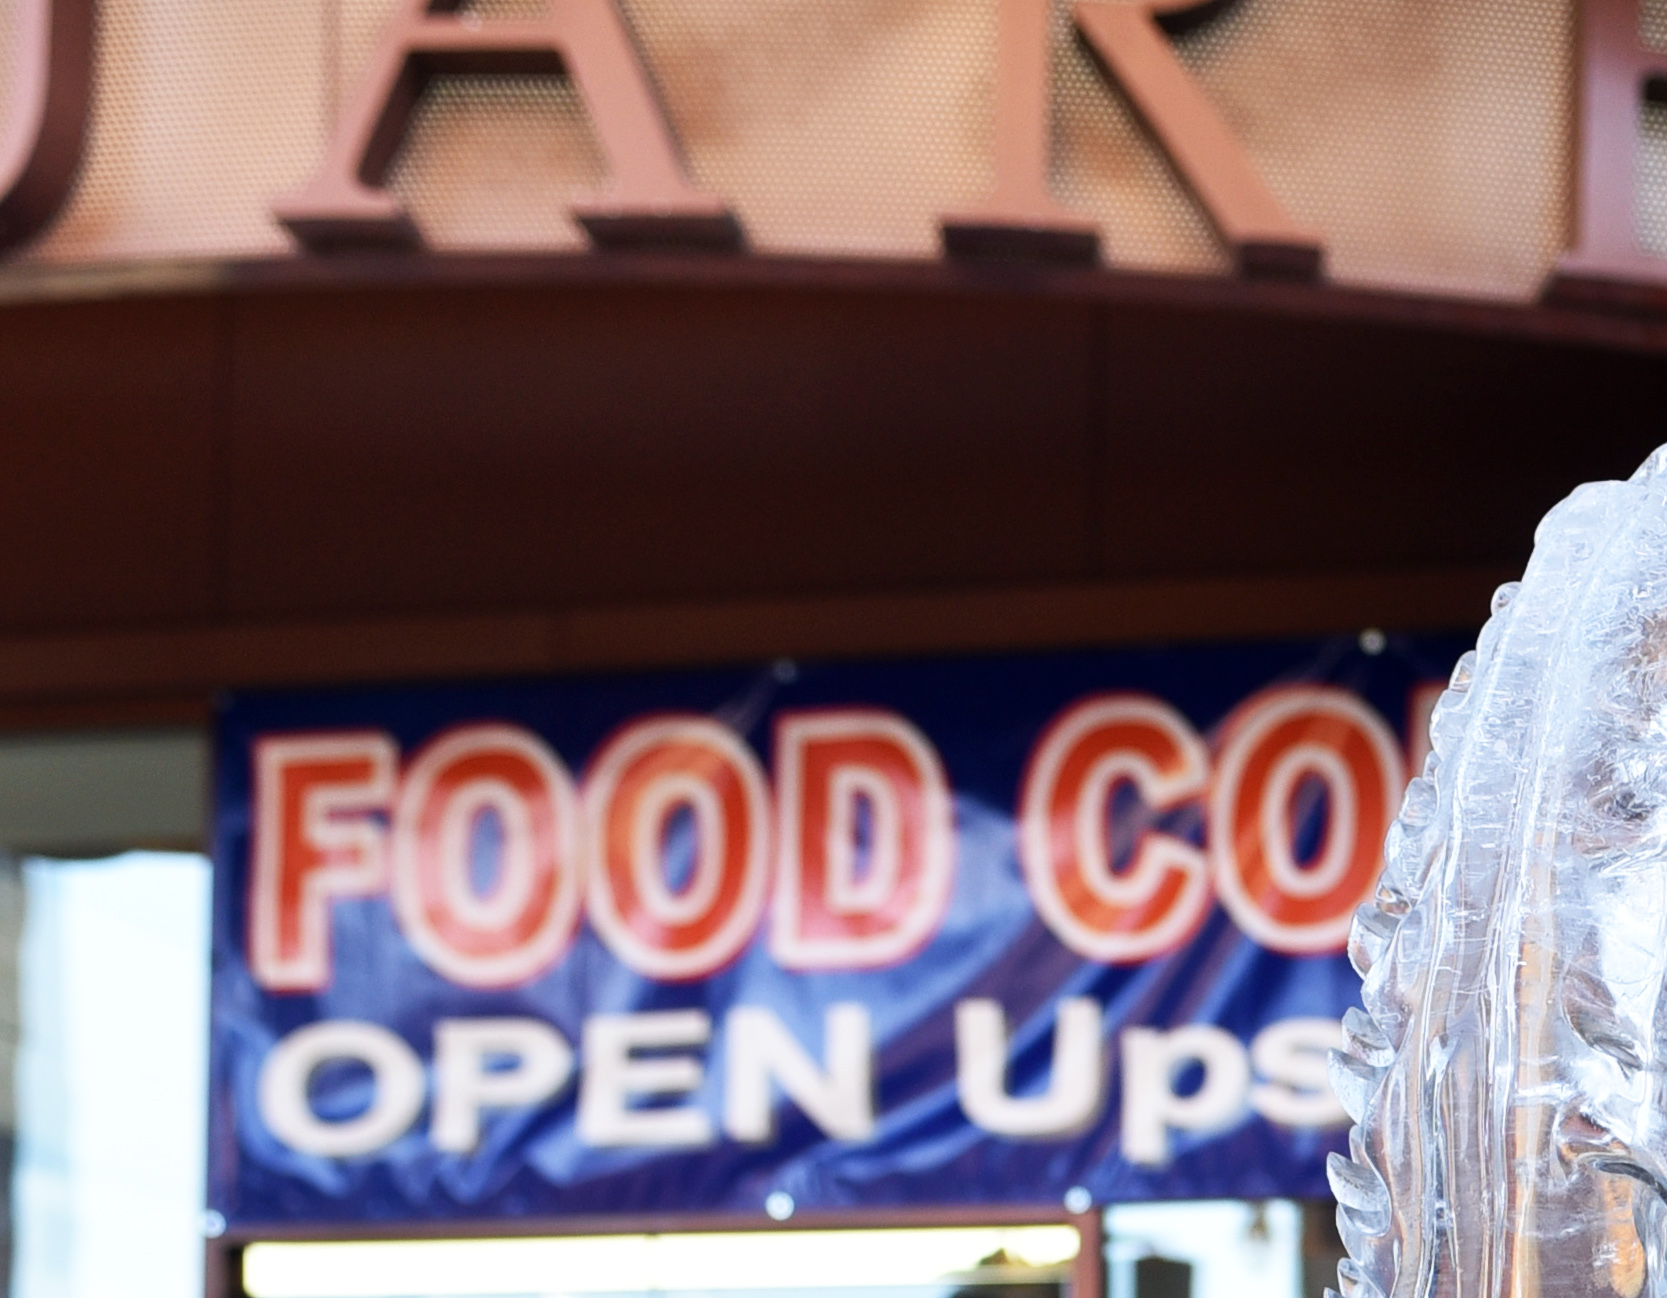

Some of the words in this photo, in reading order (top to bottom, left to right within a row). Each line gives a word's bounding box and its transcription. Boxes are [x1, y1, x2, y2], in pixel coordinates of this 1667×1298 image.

[249, 705, 950, 992] FOOD
[1018, 682, 1446, 963] CO
[256, 1000, 876, 1158] OPEN
